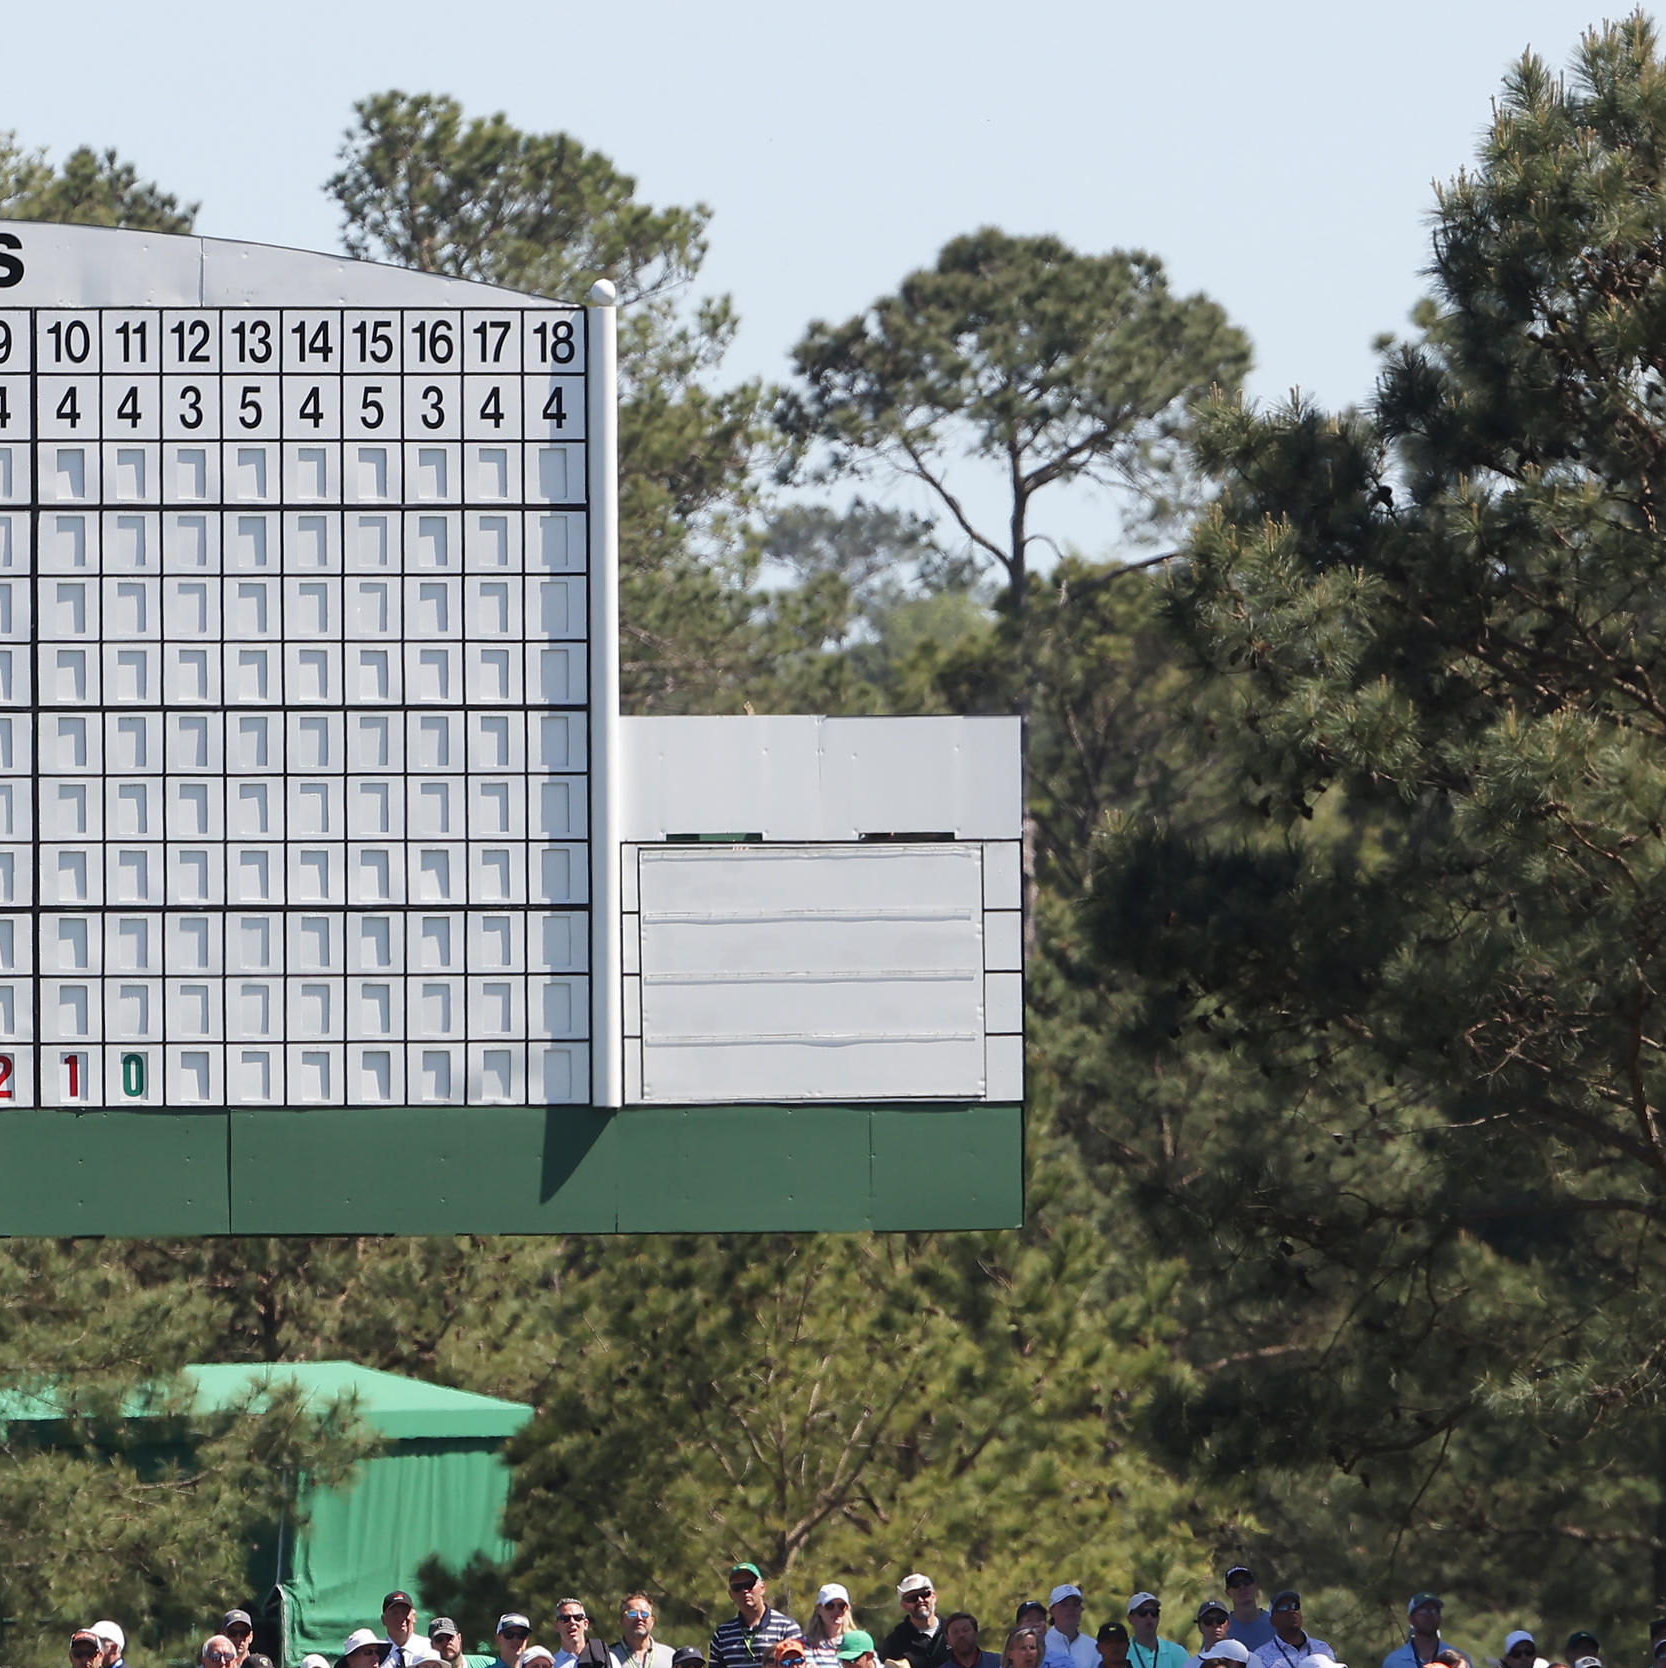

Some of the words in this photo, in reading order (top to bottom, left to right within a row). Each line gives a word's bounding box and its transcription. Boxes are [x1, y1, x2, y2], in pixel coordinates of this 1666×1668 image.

[46, 319, 91, 364] 10
[115, 320, 147, 363] 11
[170, 319, 211, 363] 12
[231, 320, 273, 364] 13
[291, 320, 334, 363] 14
[352, 320, 394, 364] 15
[411, 319, 454, 365] 16
[472, 320, 511, 363] 17
[533, 320, 576, 365] 18
[56, 386, 81, 429] 4
[117, 386, 142, 429] 4
[179, 385, 203, 430] 3
[239, 386, 263, 430] 5
[299, 386, 324, 429] 4
[360, 386, 384, 430] 5
[421, 385, 445, 430] 3
[480, 386, 505, 429] 4
[542, 386, 567, 429] 4
[64, 1054, 78, 1097] 1
[122, 1054, 145, 1097] 0
